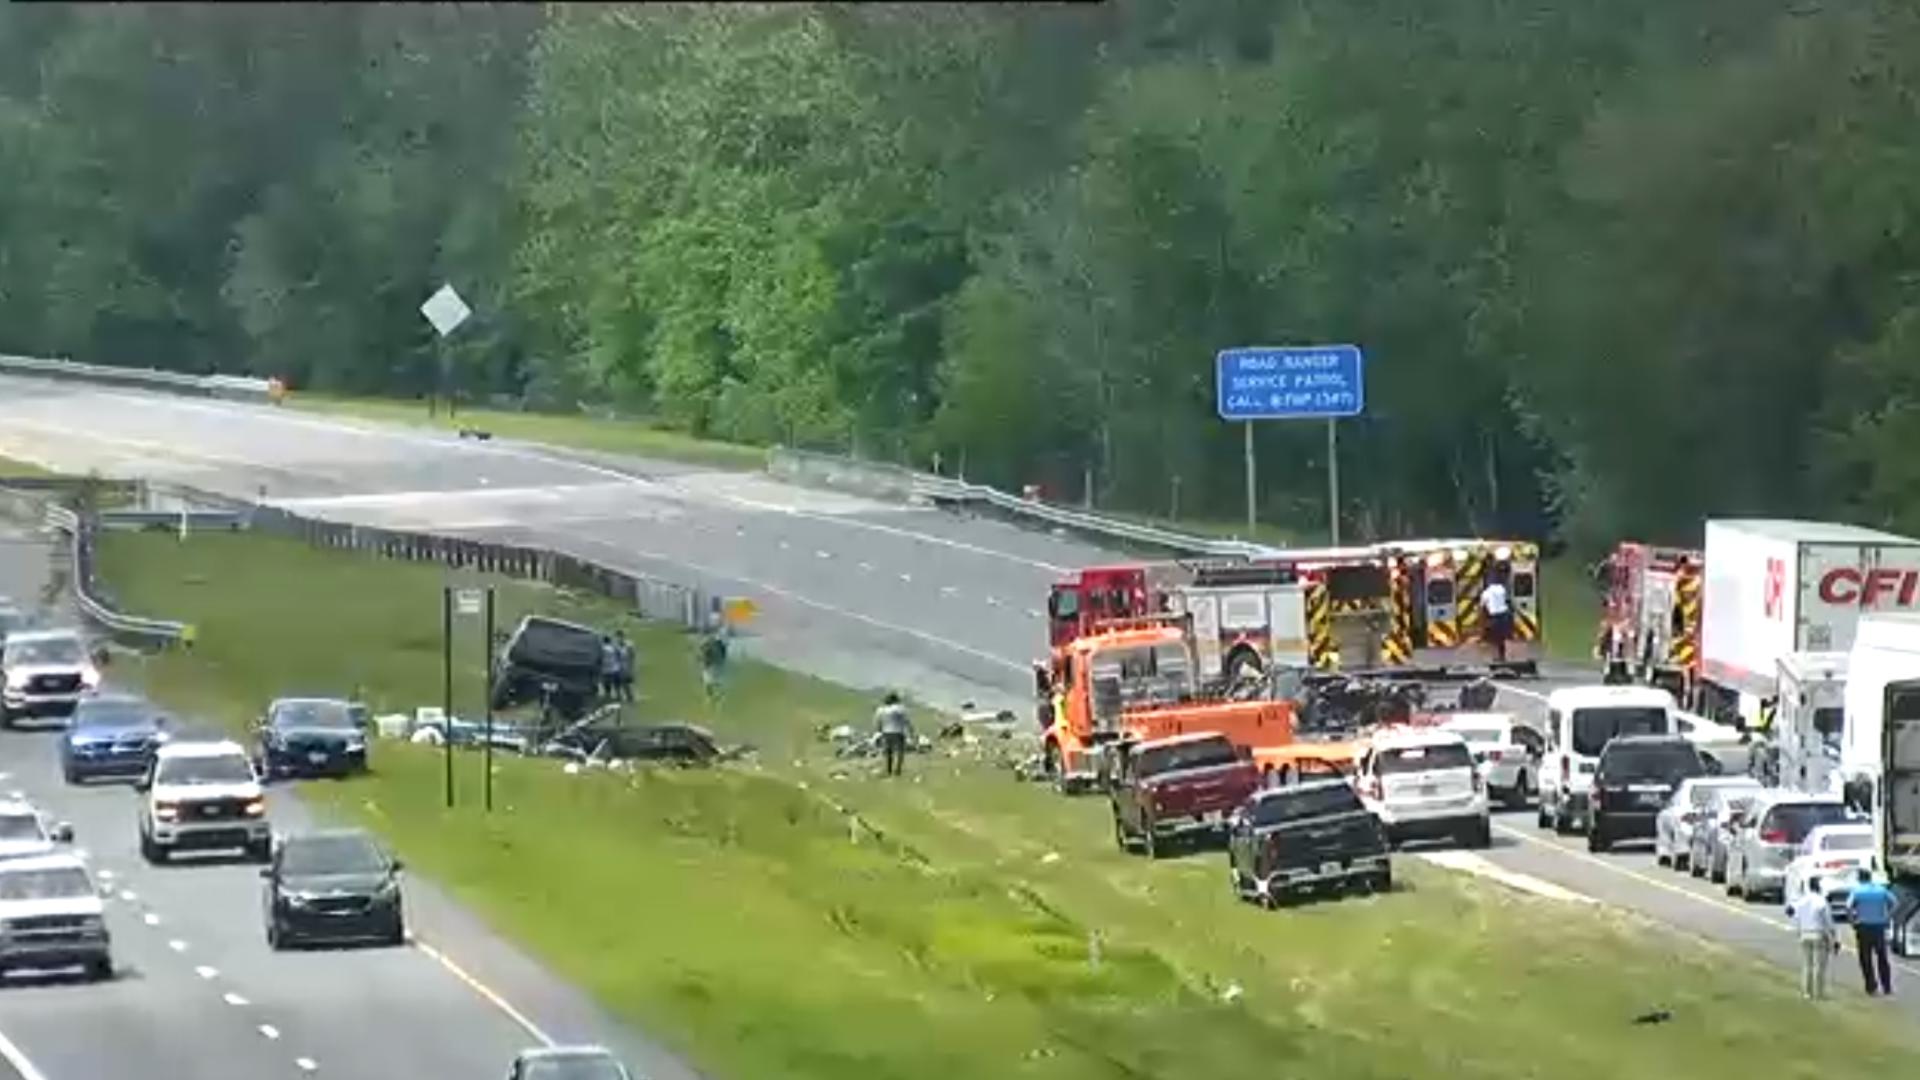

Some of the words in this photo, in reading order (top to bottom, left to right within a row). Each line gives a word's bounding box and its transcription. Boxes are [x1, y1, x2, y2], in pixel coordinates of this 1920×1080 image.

[1239, 356, 1275, 369] ROAD
[1283, 354, 1340, 368] RANGER
[1232, 374, 1287, 390] SERVICE
[1295, 373, 1348, 387] PATROL
[1227, 394, 1262, 409] CALL
[1819, 567, 1919, 606] CFI
